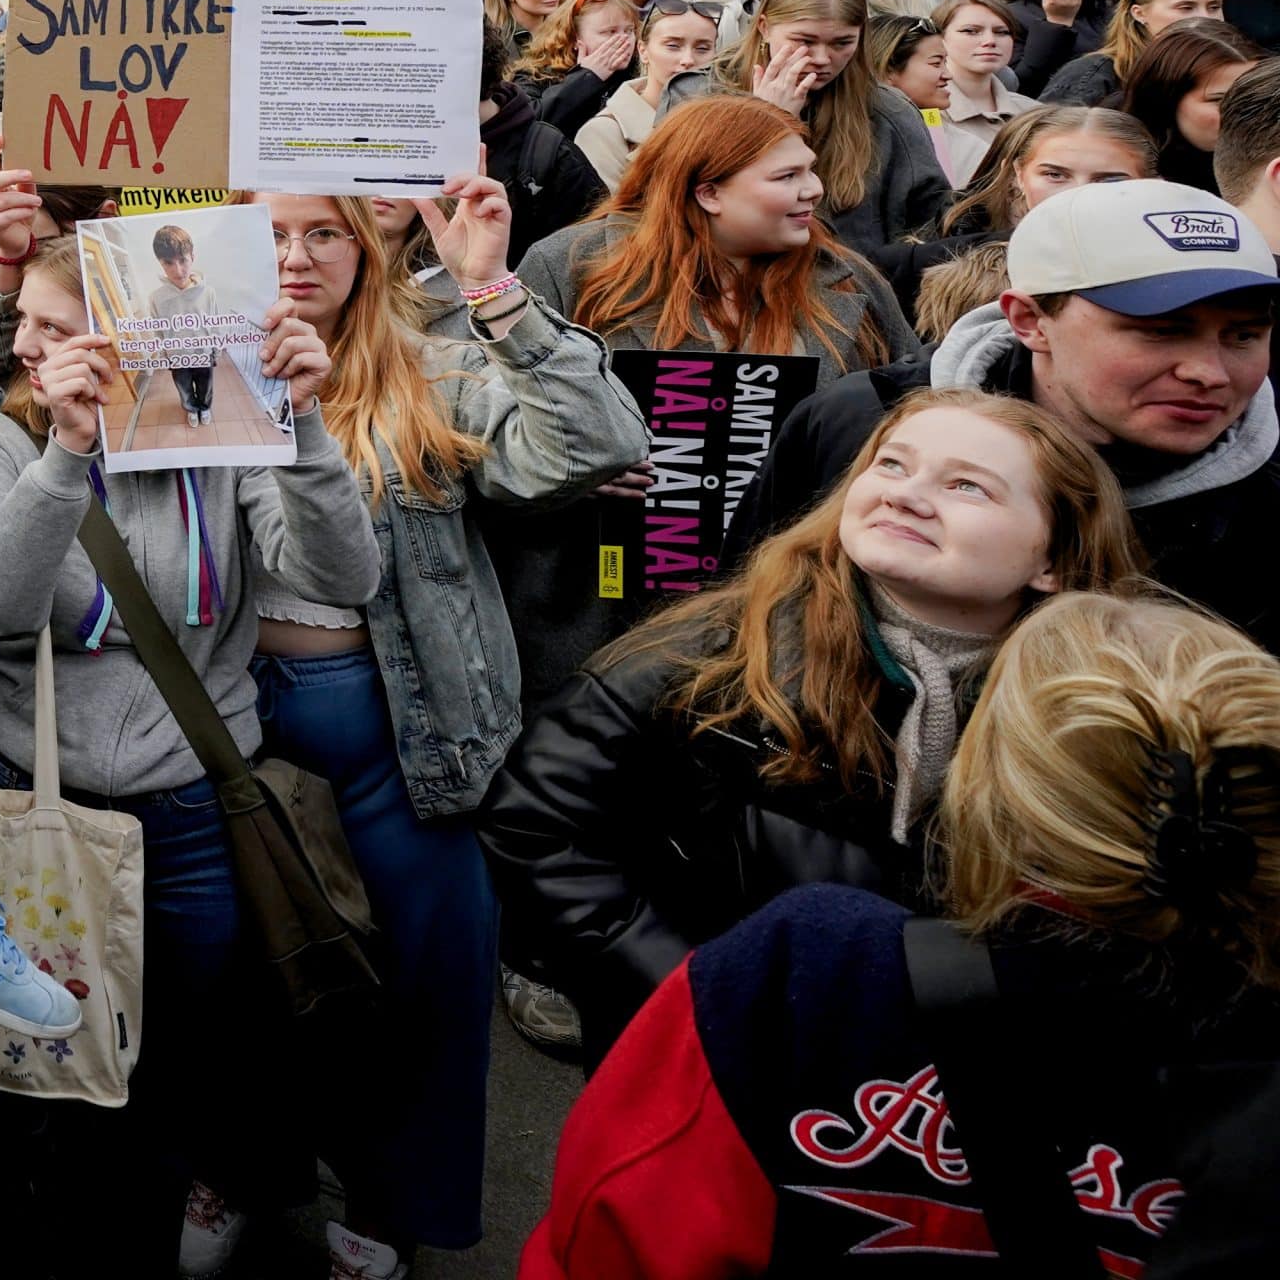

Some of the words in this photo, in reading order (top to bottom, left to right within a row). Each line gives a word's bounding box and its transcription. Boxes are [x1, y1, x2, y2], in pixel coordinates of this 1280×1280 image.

[80, 42, 188, 93] LOV
[44, 88, 189, 174] NÅ!
[1182, 238, 1229, 246] COMPANY
[117, 317, 169, 332] Kristian
[173, 314, 200, 331] (16)
[203, 313, 246, 326] kunne
[121, 338, 163, 354] trengt
[164, 339, 182, 349] en
[122, 356, 171, 370] høsten
[172, 354, 211, 368] 2022
